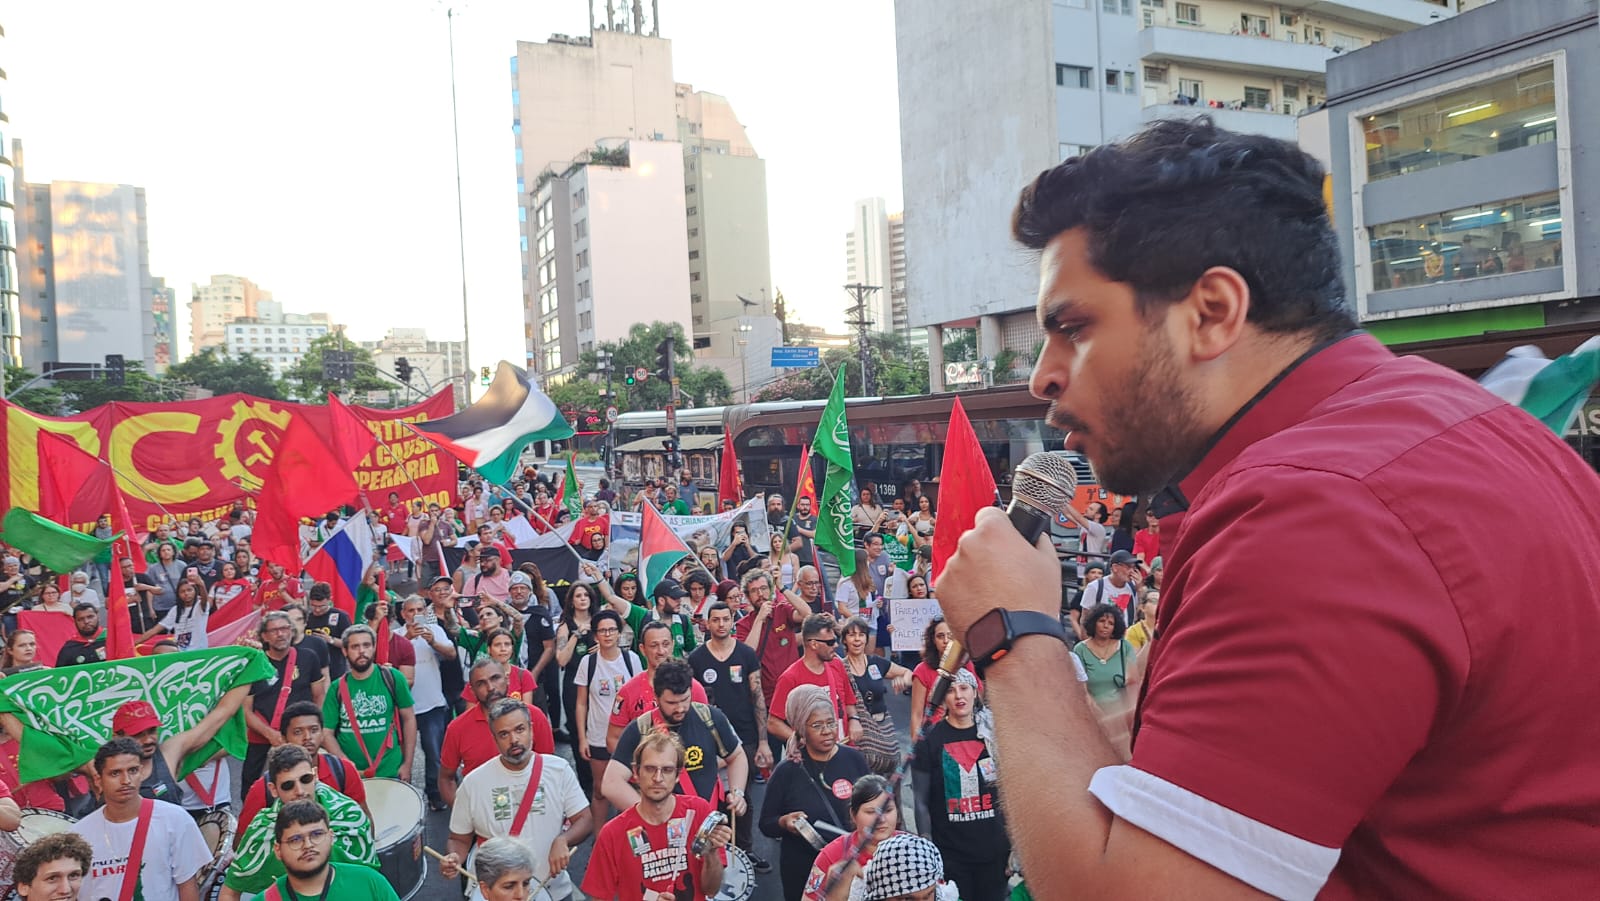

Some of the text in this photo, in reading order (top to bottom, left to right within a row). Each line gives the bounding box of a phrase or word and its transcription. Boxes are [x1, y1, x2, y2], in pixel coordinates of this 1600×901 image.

[879, 483, 896, 496] 1369
[947, 793, 993, 814] FREE
[948, 809, 996, 822] PALESTINE
[643, 858, 669, 871] ZUMBI
[92, 865, 126, 878] LIVR
